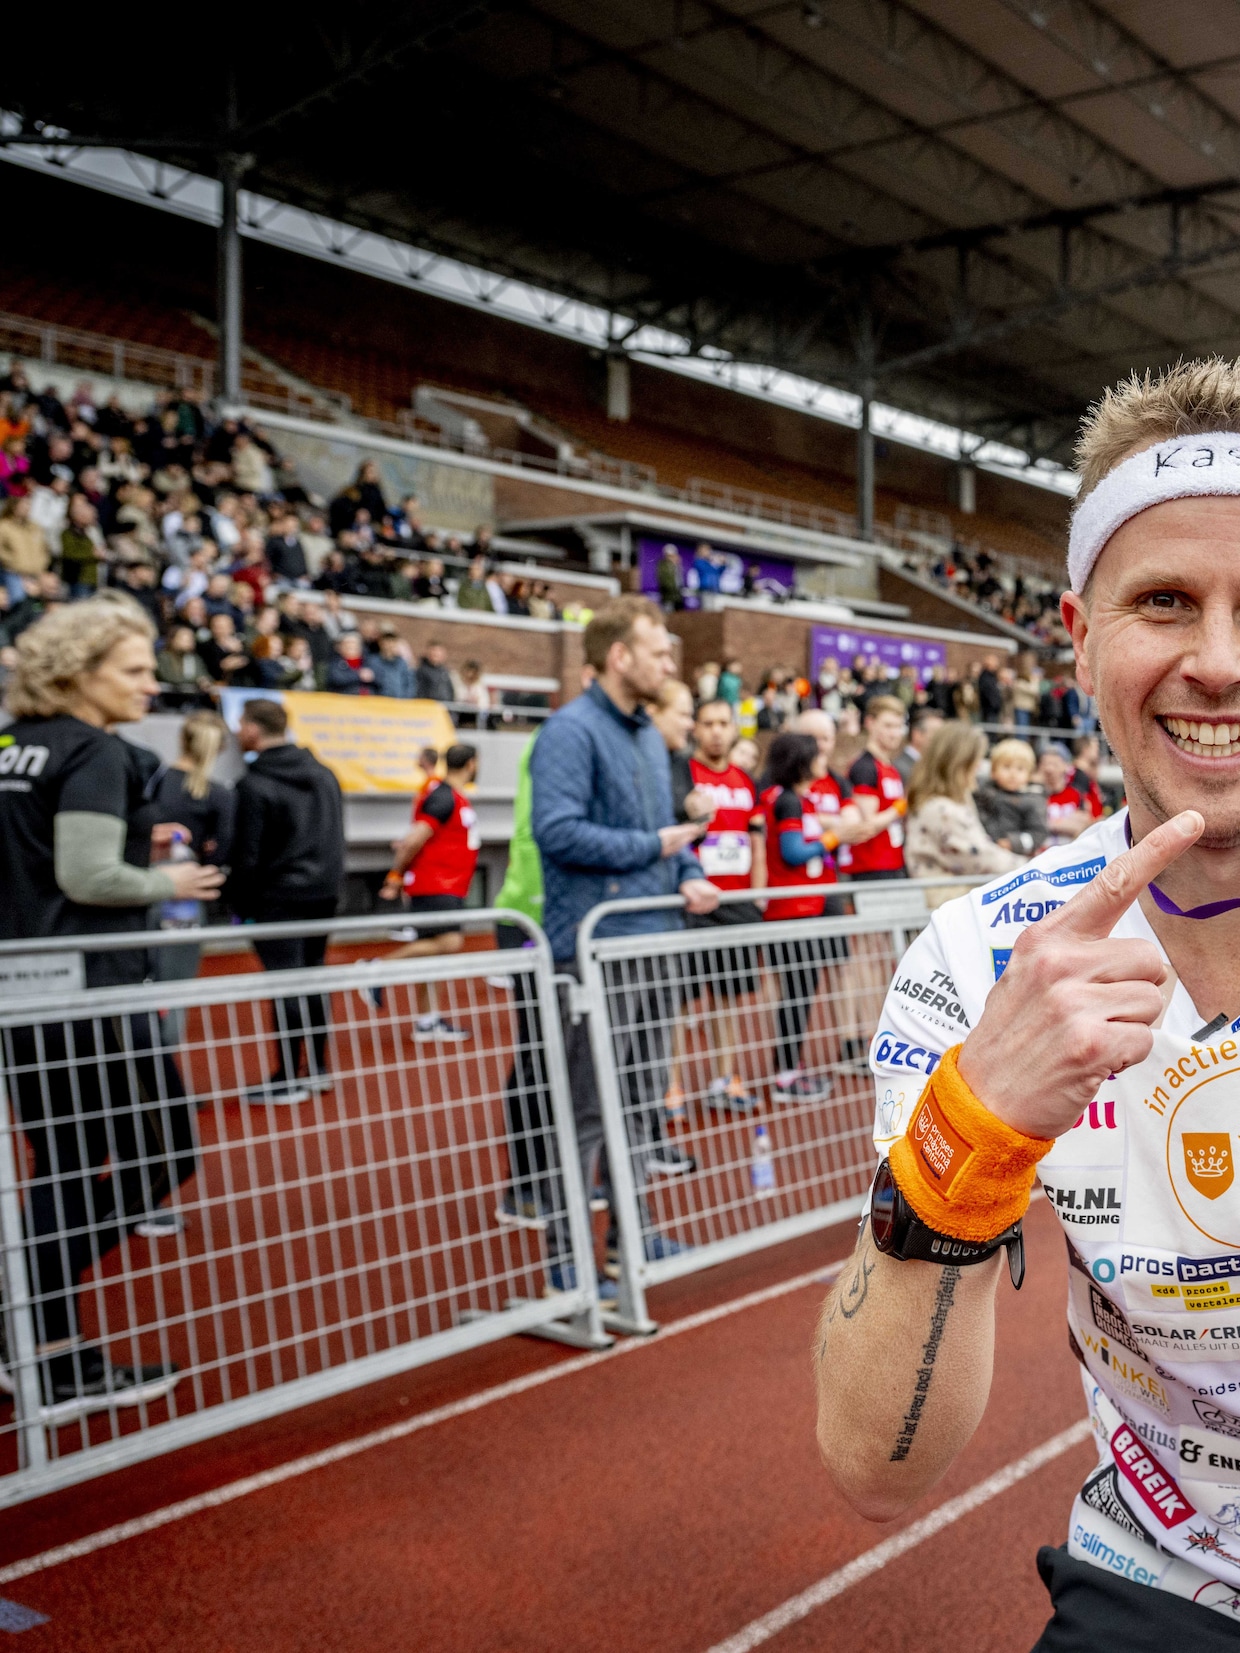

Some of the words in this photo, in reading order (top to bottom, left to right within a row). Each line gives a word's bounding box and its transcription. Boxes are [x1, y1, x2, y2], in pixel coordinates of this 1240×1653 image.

[989, 879, 1020, 900] Staal
[1144, 1085, 1170, 1116] in
[1163, 1039, 1238, 1089] actie
[1062, 1212, 1120, 1224] KLEDING
[1186, 1284, 1225, 1295] proces
[1173, 1342, 1207, 1350] ALLES
[1209, 1341, 1229, 1350] UIT
[1114, 1430, 1186, 1520] BEREIK
